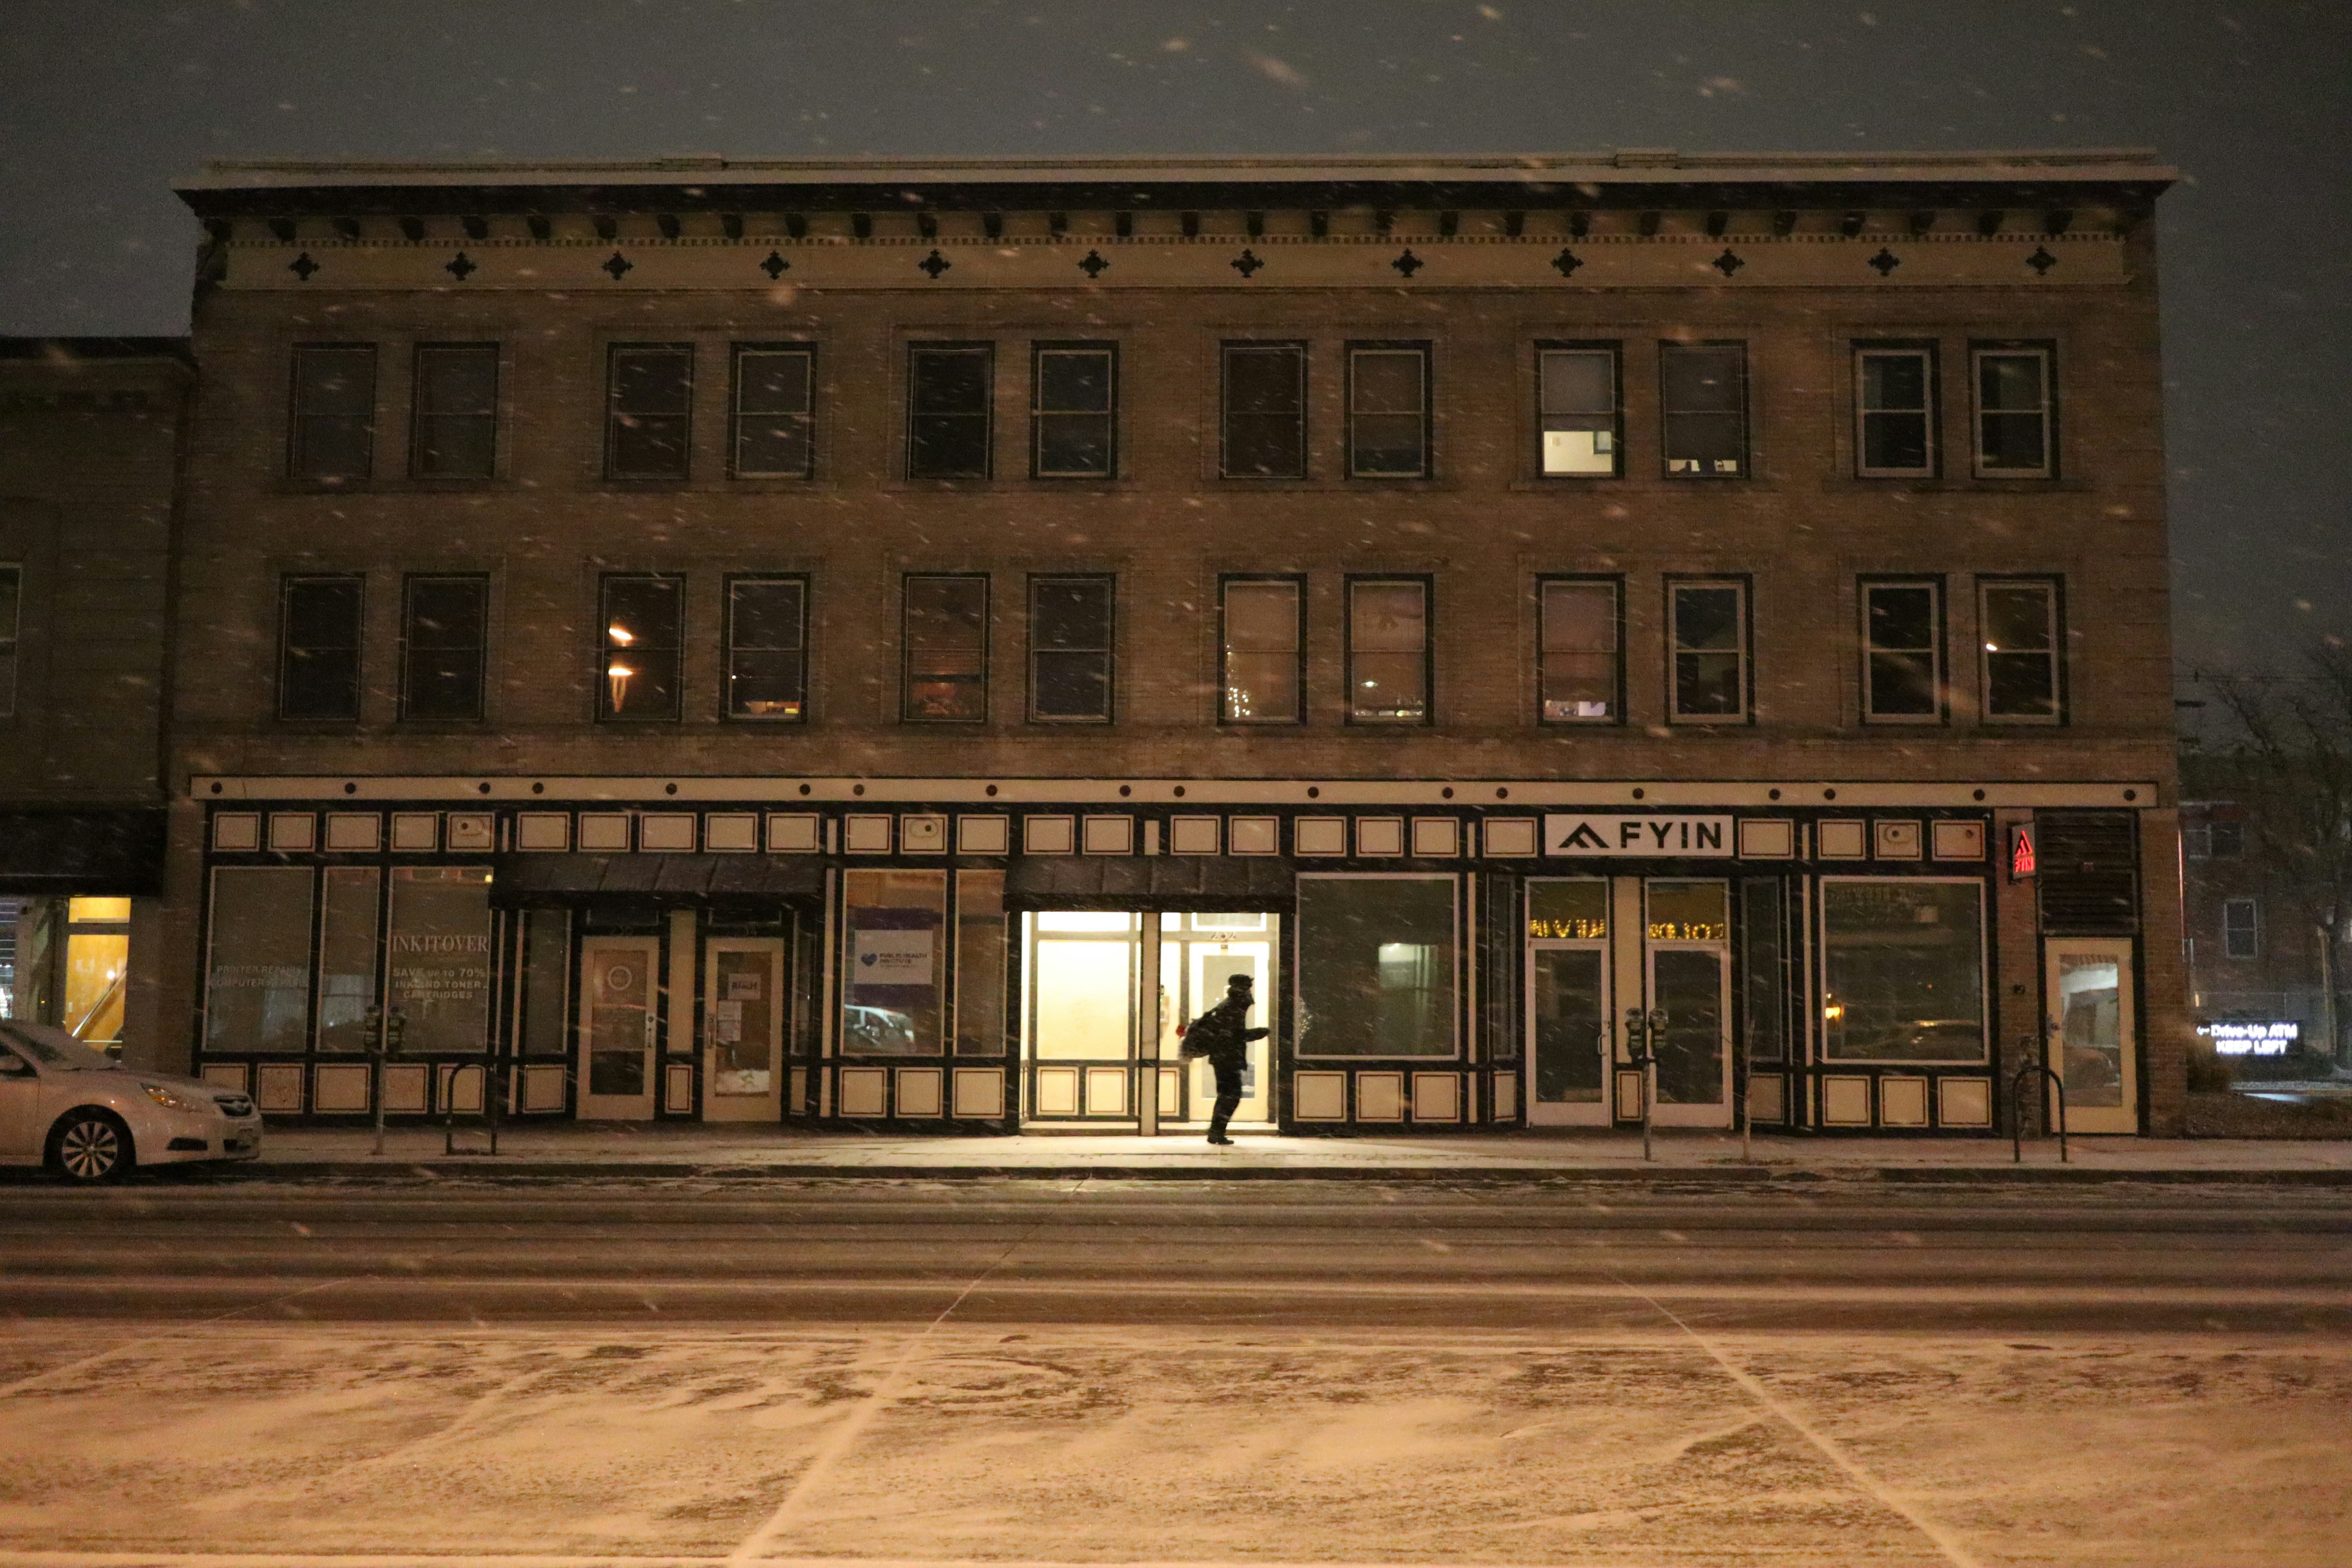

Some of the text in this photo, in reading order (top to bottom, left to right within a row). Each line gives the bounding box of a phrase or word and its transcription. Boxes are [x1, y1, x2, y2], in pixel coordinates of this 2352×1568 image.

[1621, 822, 1721, 849] FYIN
[2014, 855, 2035, 873] FYIN
[392, 935, 422, 952] INK
[442, 935, 489, 952] OVER
[216, 965, 302, 974] PRINTER REPAIRS
[393, 967, 424, 977] SAVE
[459, 967, 485, 977] 70%
[403, 991, 473, 999] CARTRIDGES
[2210, 1023, 2298, 1039] Drive-Up ATM
[2216, 1040, 2288, 1054] KEEP LEFT
